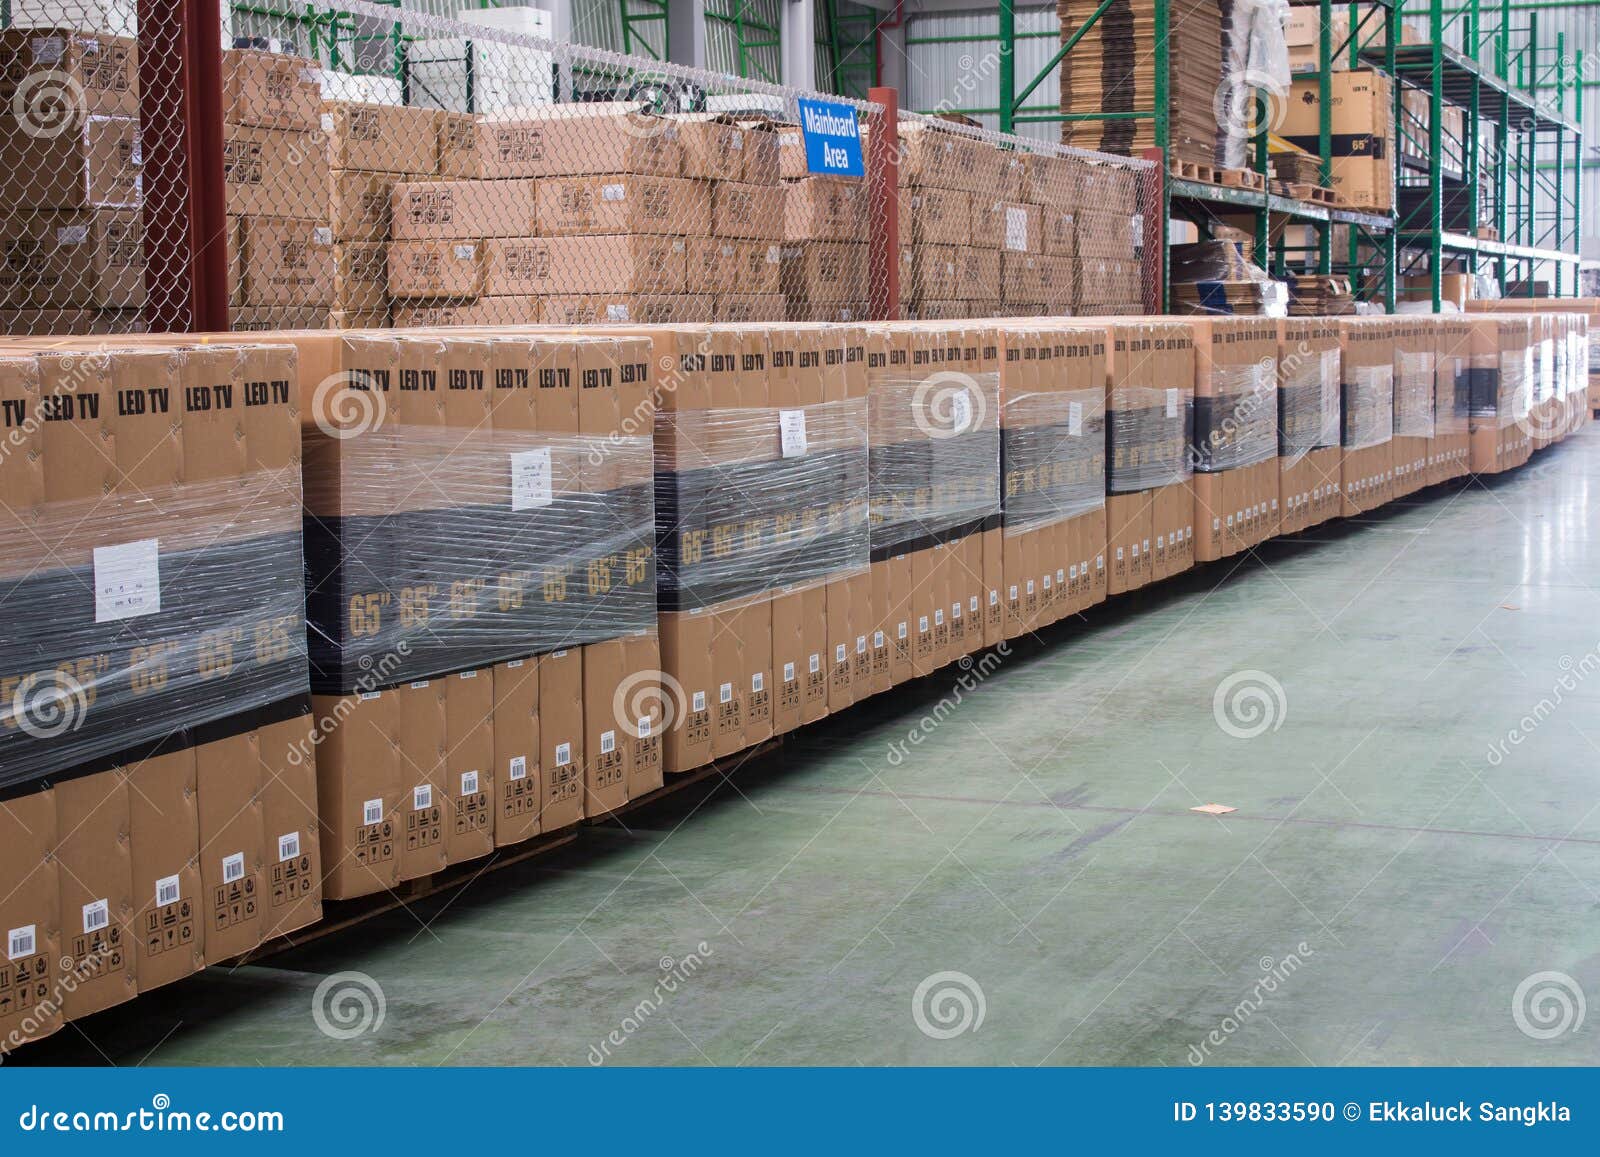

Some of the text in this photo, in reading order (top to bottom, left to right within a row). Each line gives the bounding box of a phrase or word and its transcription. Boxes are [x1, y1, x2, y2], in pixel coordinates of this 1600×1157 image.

[804, 107, 856, 138] Mainboard
[824, 142, 849, 168] Area
[712, 354, 735, 372] LED TV
[742, 354, 764, 370] LED TV
[773, 350, 793, 367] LED TV
[373, 369, 390, 391] TV
[400, 369, 437, 391] LED TV
[449, 369, 484, 390] LED TV
[495, 368, 529, 389] LED TV
[539, 368, 570, 389] LED TV
[583, 368, 612, 389] LED TV
[621, 363, 648, 383] LED TV
[118, 388, 169, 416] LED TV
[186, 385, 233, 412] LED TV
[244, 380, 289, 407] LED TV
[2, 399, 26, 427] TV
[43, 393, 99, 421] LED TV
[350, 592, 391, 636] 65"
